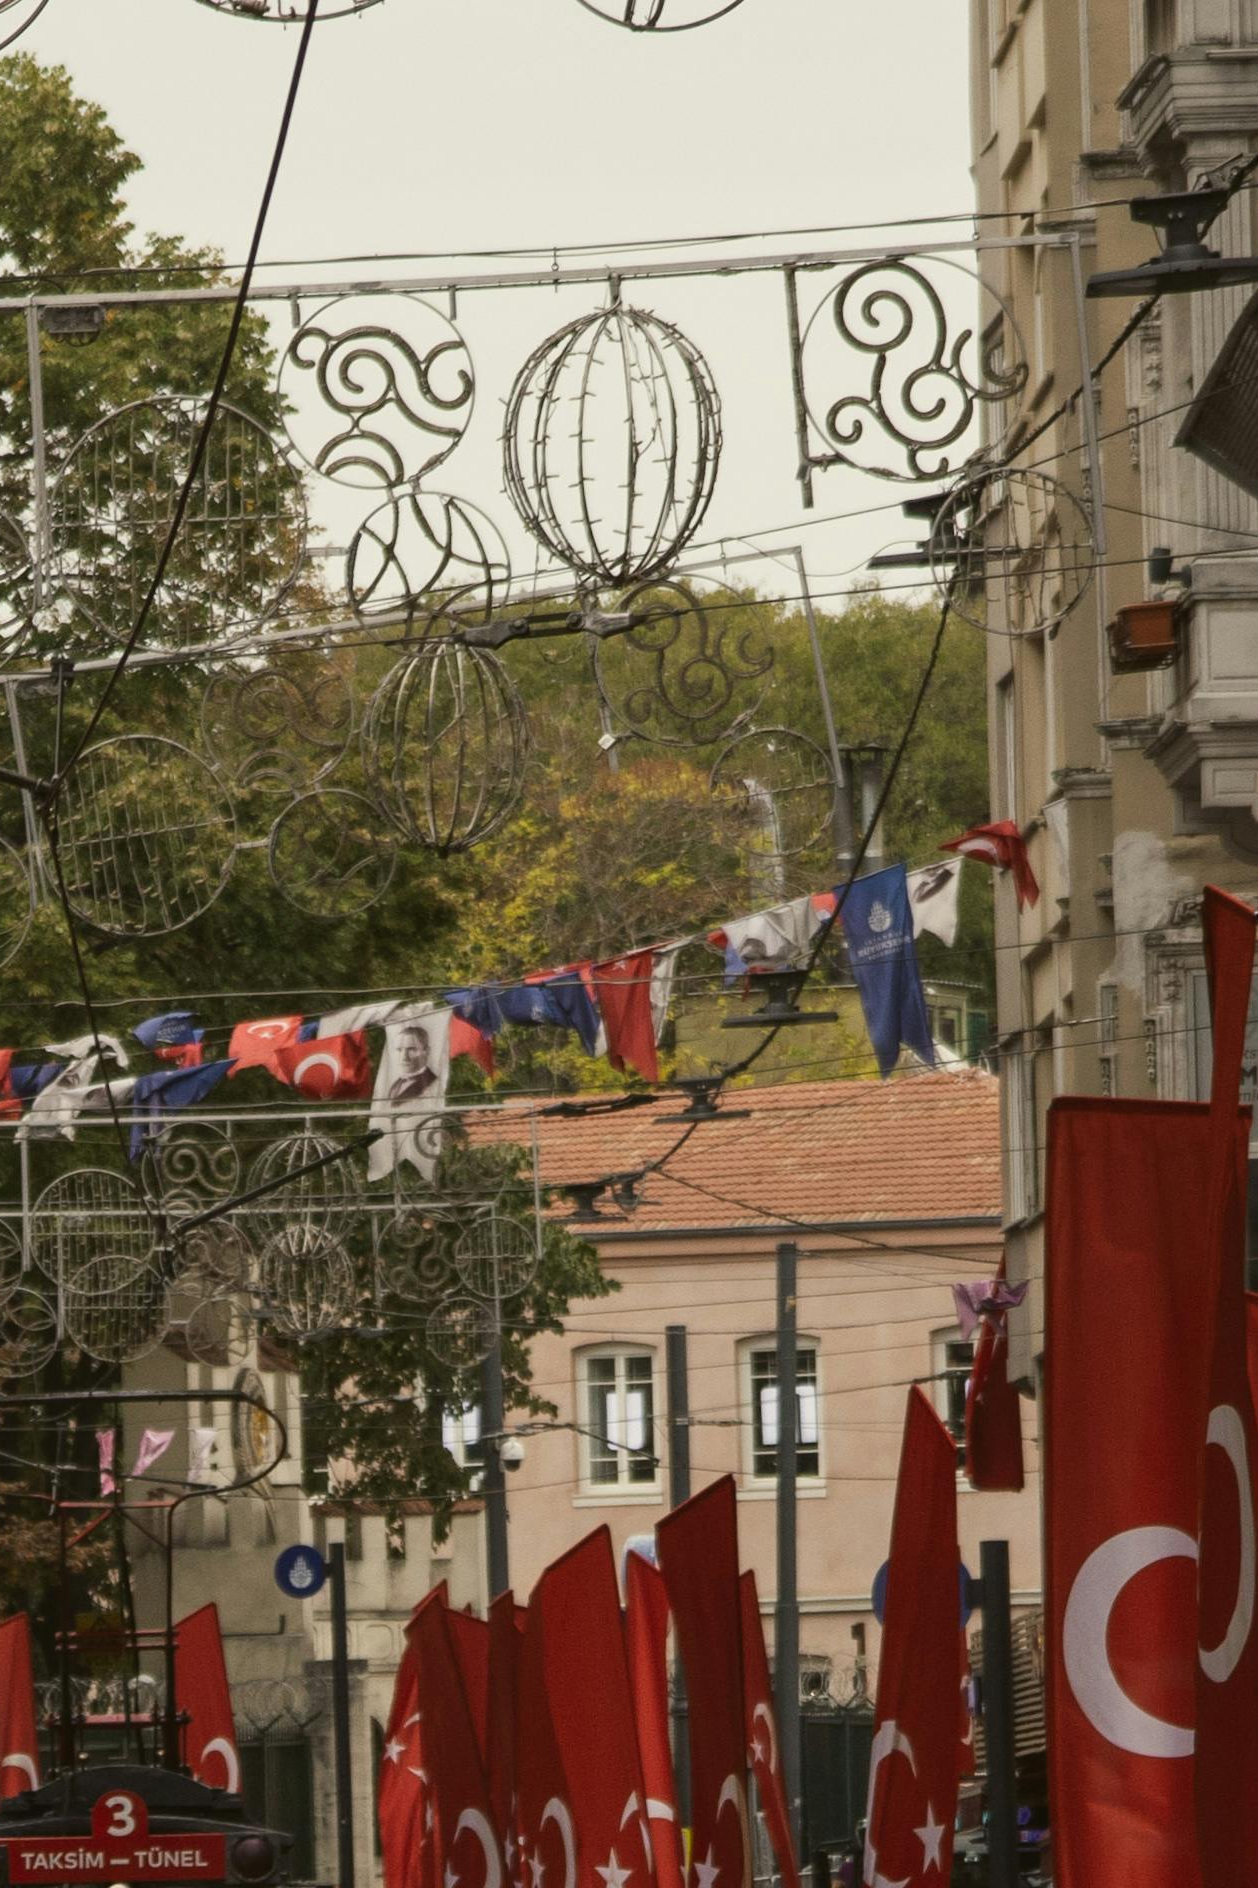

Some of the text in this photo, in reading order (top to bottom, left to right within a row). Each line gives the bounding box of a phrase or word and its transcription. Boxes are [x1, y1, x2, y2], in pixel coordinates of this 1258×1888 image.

[105, 1796, 136, 1836] 3
[21, 1848, 104, 1870] TAKSİM
[134, 1847, 208, 1868] TÜNEL
